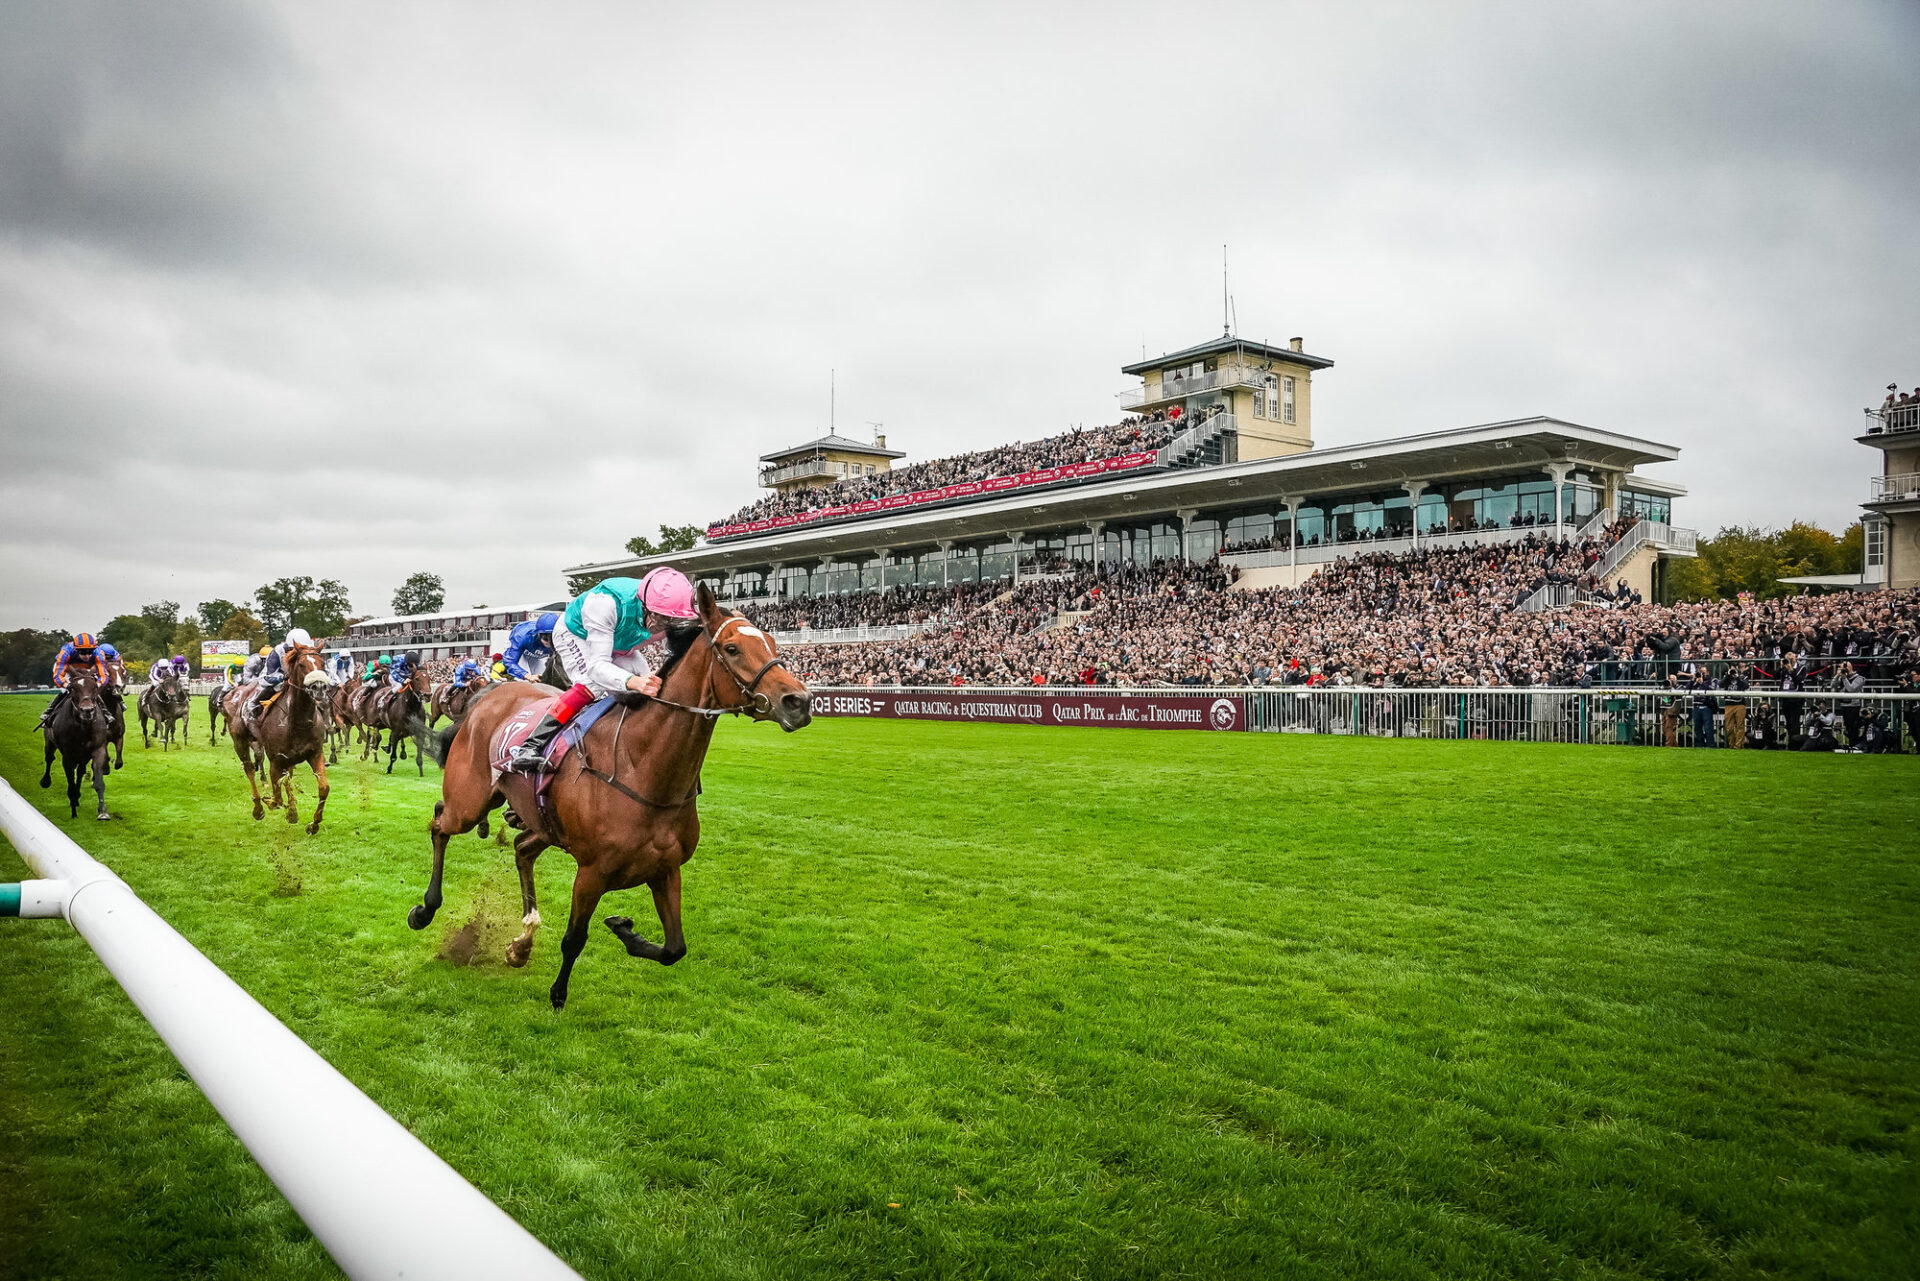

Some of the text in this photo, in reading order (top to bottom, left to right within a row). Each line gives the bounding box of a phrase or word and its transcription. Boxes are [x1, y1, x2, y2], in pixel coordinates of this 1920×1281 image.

[567, 639, 588, 675] DETTORI
[833, 696, 871, 714] SERIES
[894, 700, 1043, 719] QATAR RACING & EQUESTRIAN CLUB
[498, 721, 529, 761] 17
